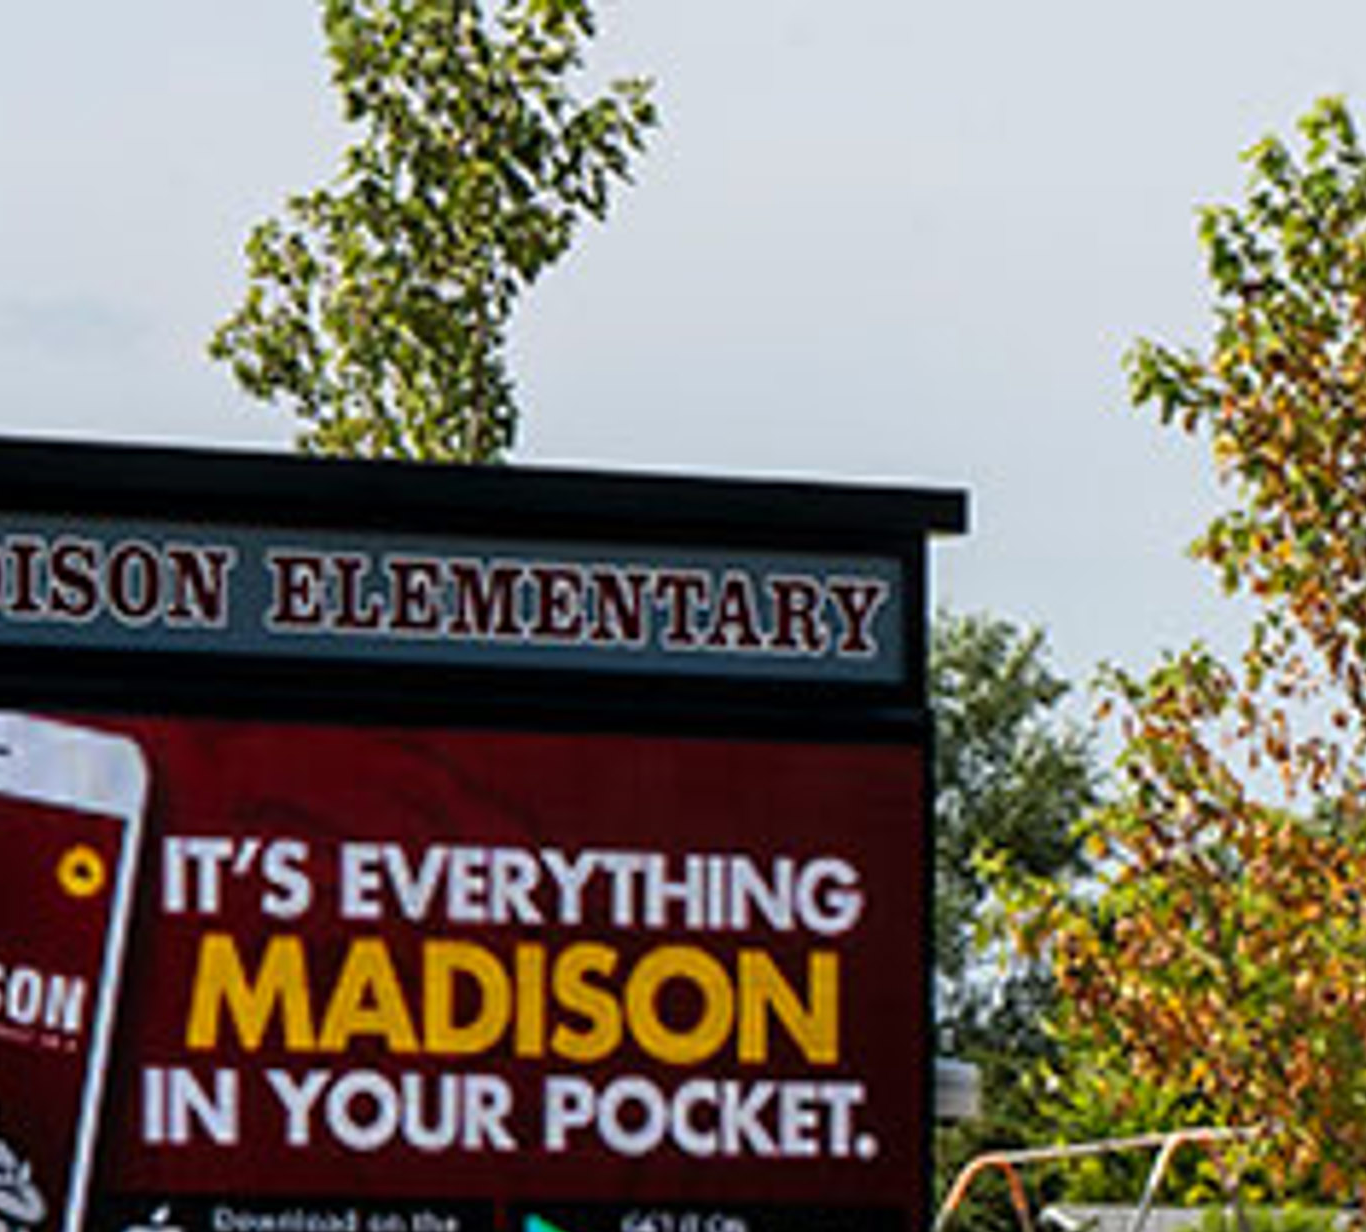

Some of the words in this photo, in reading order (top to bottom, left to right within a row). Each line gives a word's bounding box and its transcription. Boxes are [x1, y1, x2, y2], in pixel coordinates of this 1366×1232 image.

[266, 547, 887, 658] ELEMENTARY
[162, 835, 314, 919] IT'S
[340, 841, 864, 935] EVERYTHING
[184, 933, 840, 1065] MADISON
[143, 1067, 238, 1146] IN
[266, 1067, 516, 1151] YOUR
[543, 1075, 878, 1159] POCKET.
